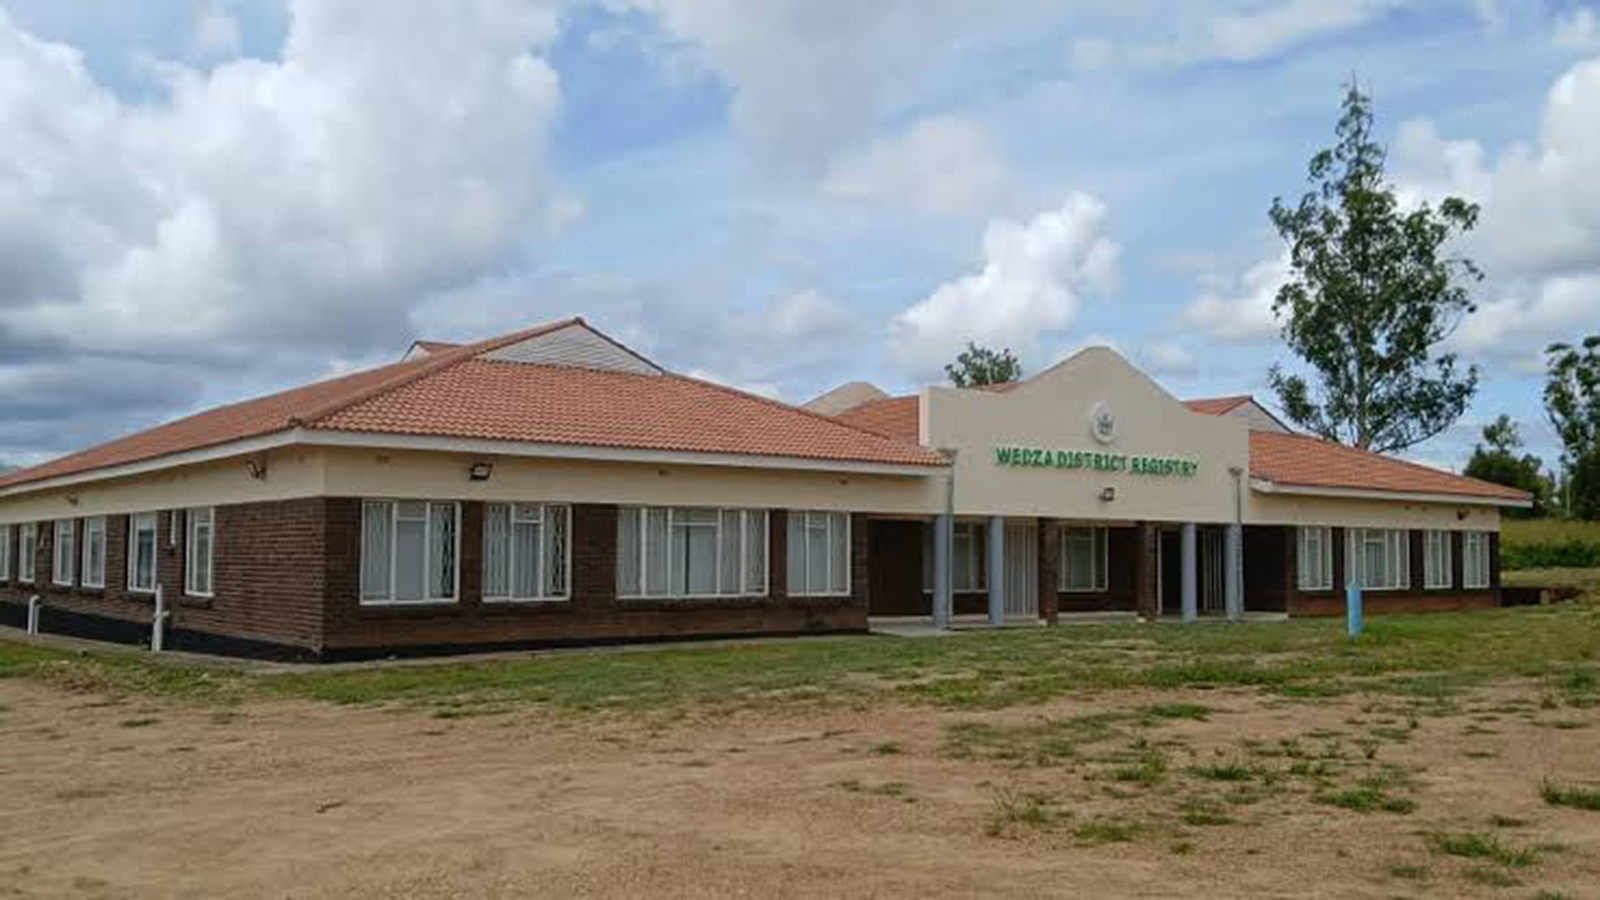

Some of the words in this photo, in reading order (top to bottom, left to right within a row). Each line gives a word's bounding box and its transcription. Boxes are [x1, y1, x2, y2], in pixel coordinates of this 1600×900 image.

[996, 447, 1054, 468] WEDZA
[1055, 450, 1128, 472] DISTRICT
[1130, 456, 1198, 477] REGISTRY
